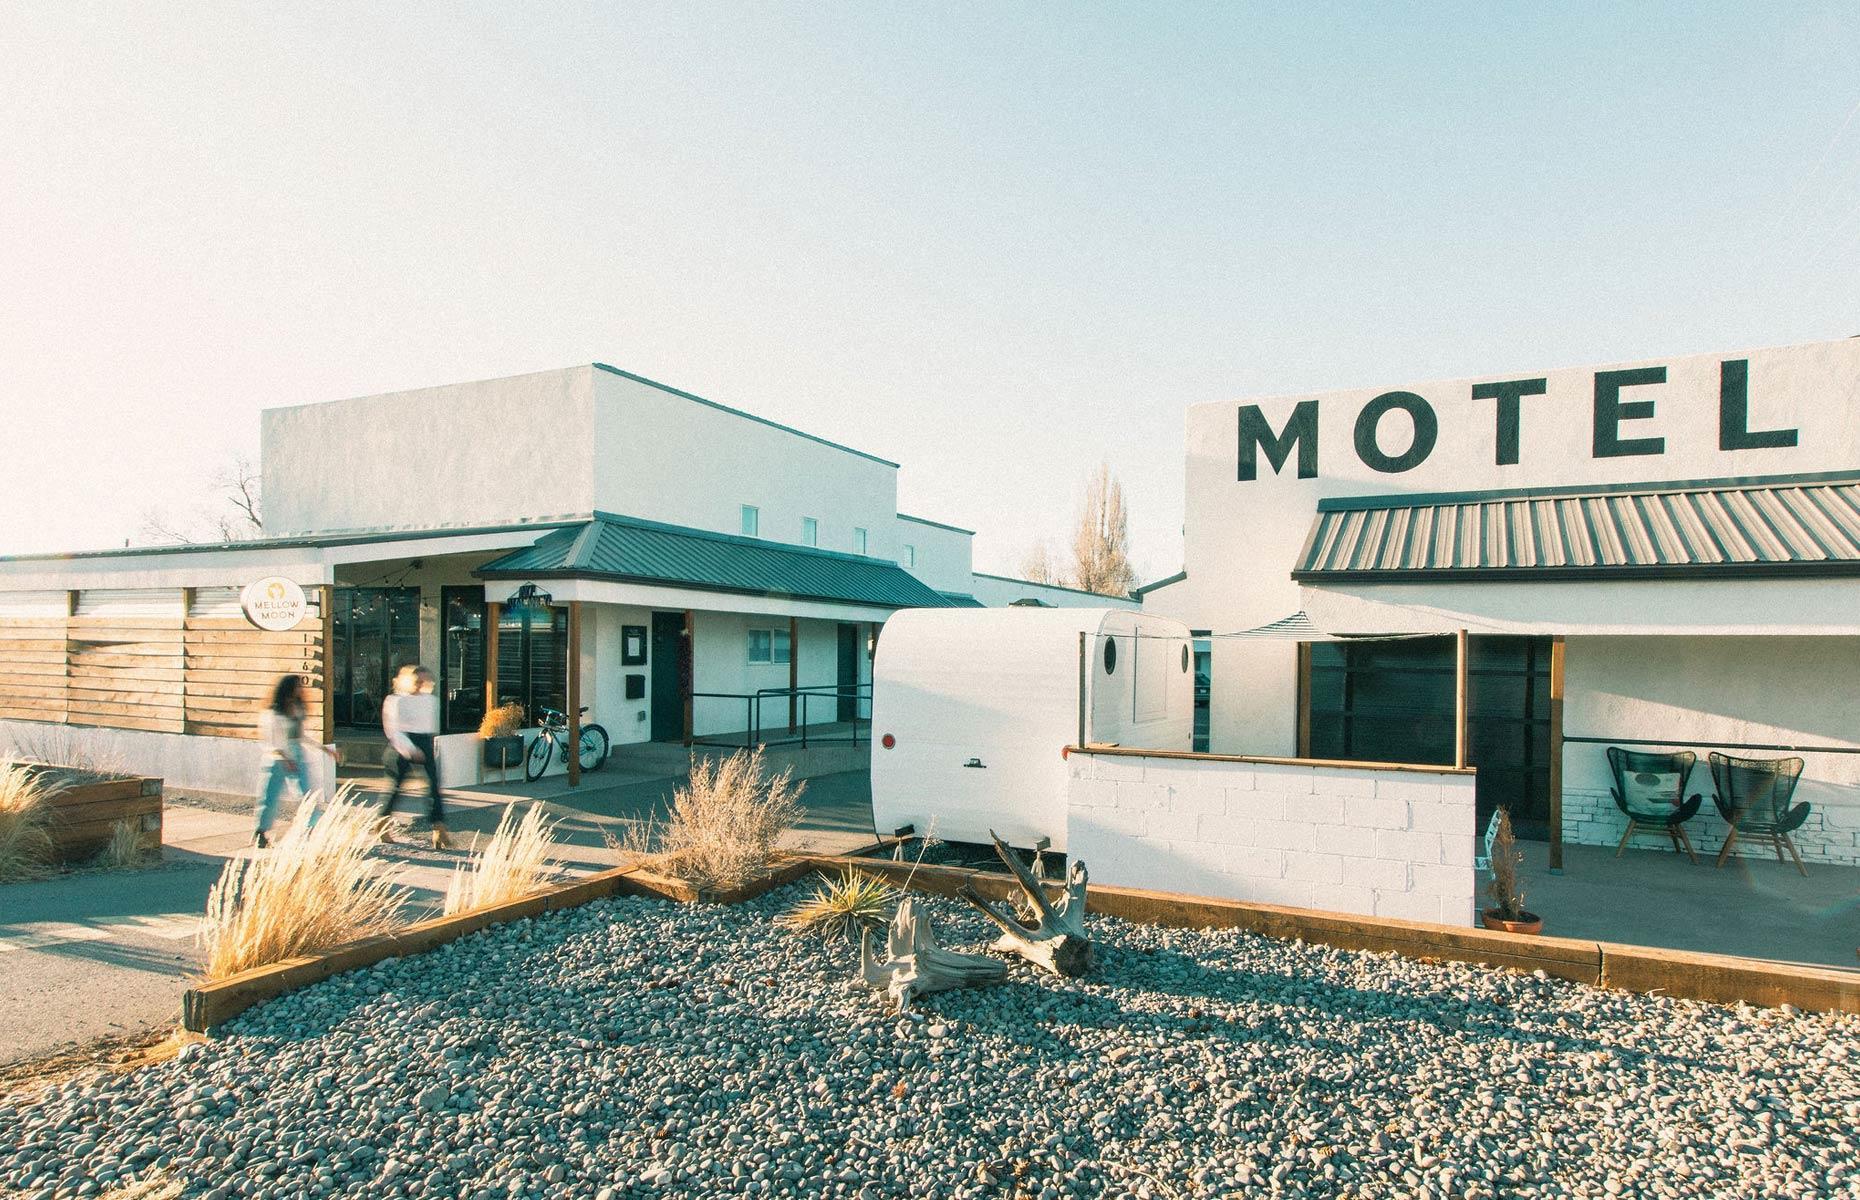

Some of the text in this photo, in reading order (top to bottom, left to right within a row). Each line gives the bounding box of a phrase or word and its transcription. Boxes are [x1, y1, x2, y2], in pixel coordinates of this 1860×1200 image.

[1237, 359, 1798, 481] MOTEL
[255, 601, 299, 609] MELLOW
[261, 611, 295, 619] MOON
